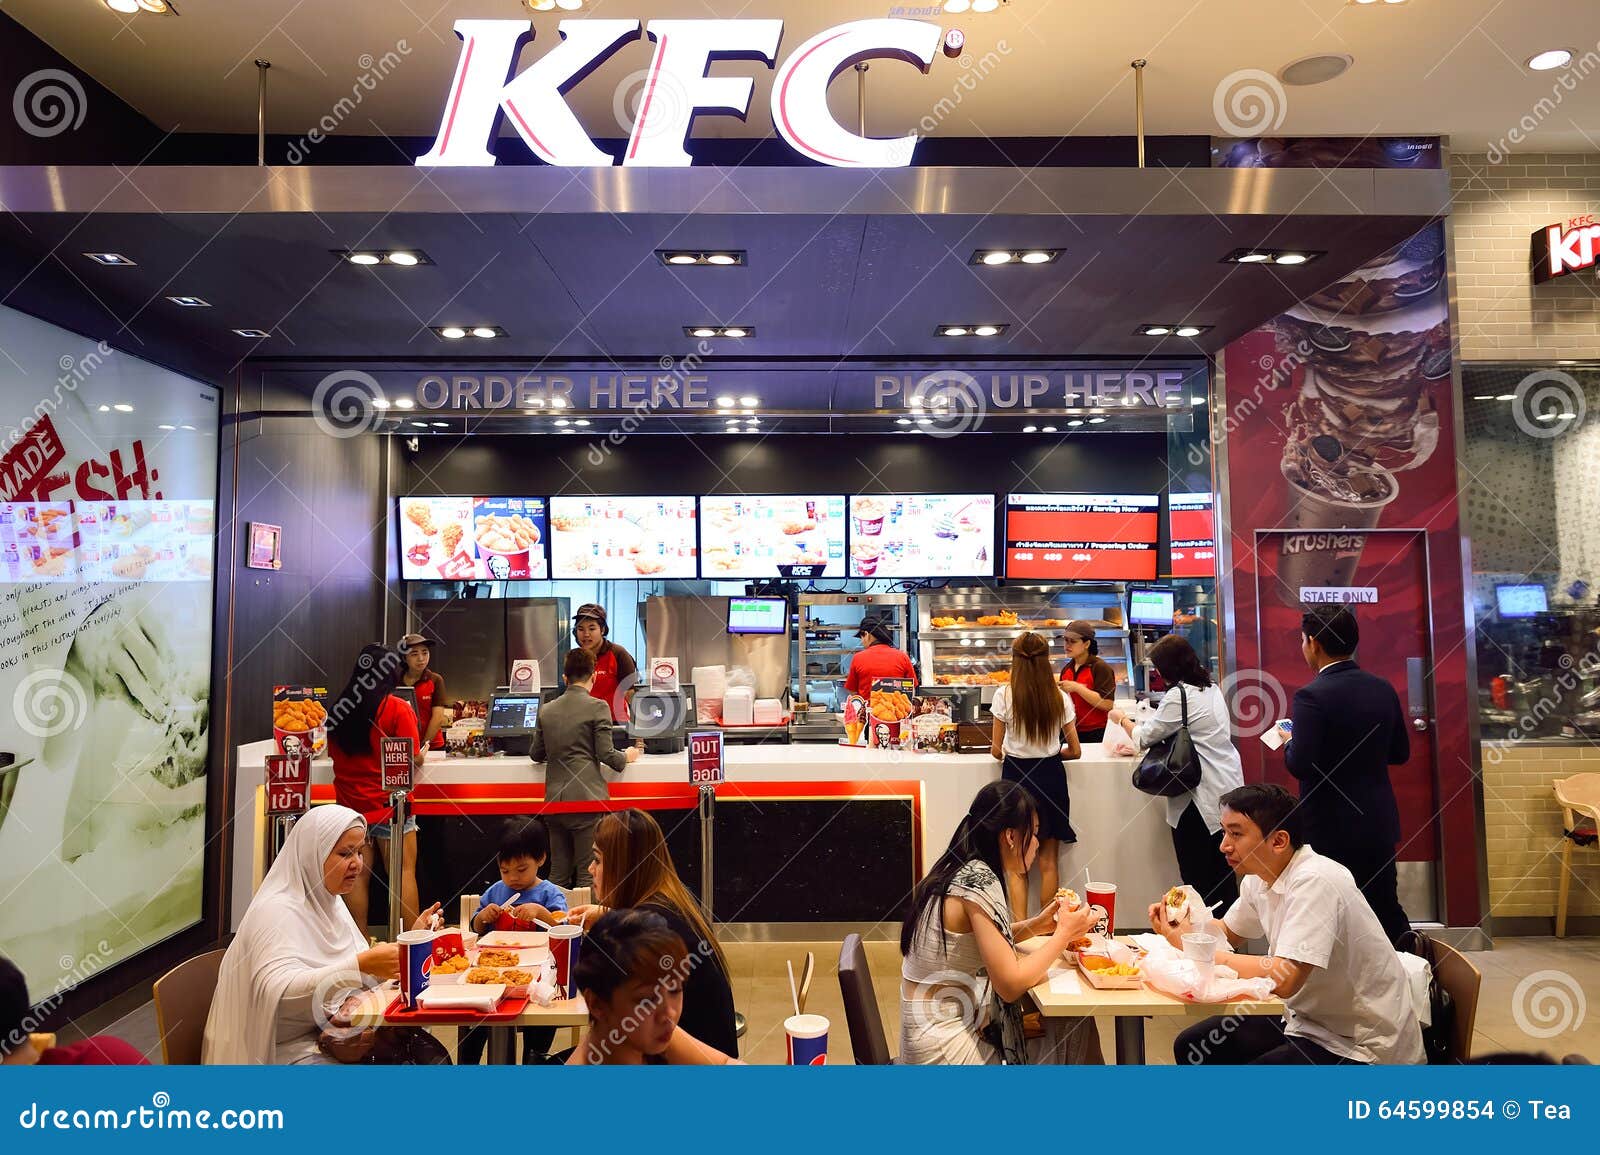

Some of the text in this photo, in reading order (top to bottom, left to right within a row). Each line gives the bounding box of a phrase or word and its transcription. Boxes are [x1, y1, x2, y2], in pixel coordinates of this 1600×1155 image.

[415, 18, 942, 168] KFC
[1568, 214, 1594, 228] KFC
[415, 375, 709, 409] ORDER HERE
[874, 372, 1183, 408] PICK UP HERE
[1093, 505, 1120, 513] Serving
[1122, 505, 1139, 513] Now
[1091, 542, 1127, 551] Preparing
[1282, 533, 1367, 555] krushers
[1303, 591, 1374, 603] STAFF ONLY
[384, 742, 407, 752] WAIT
[692, 740, 719, 754] OUT
[385, 753, 409, 762] HERE
[278, 760, 300, 778] IN
[692, 768, 720, 781] ออก
[385, 770, 410, 785] รอที่นี่
[272, 787, 304, 809] เข้า
